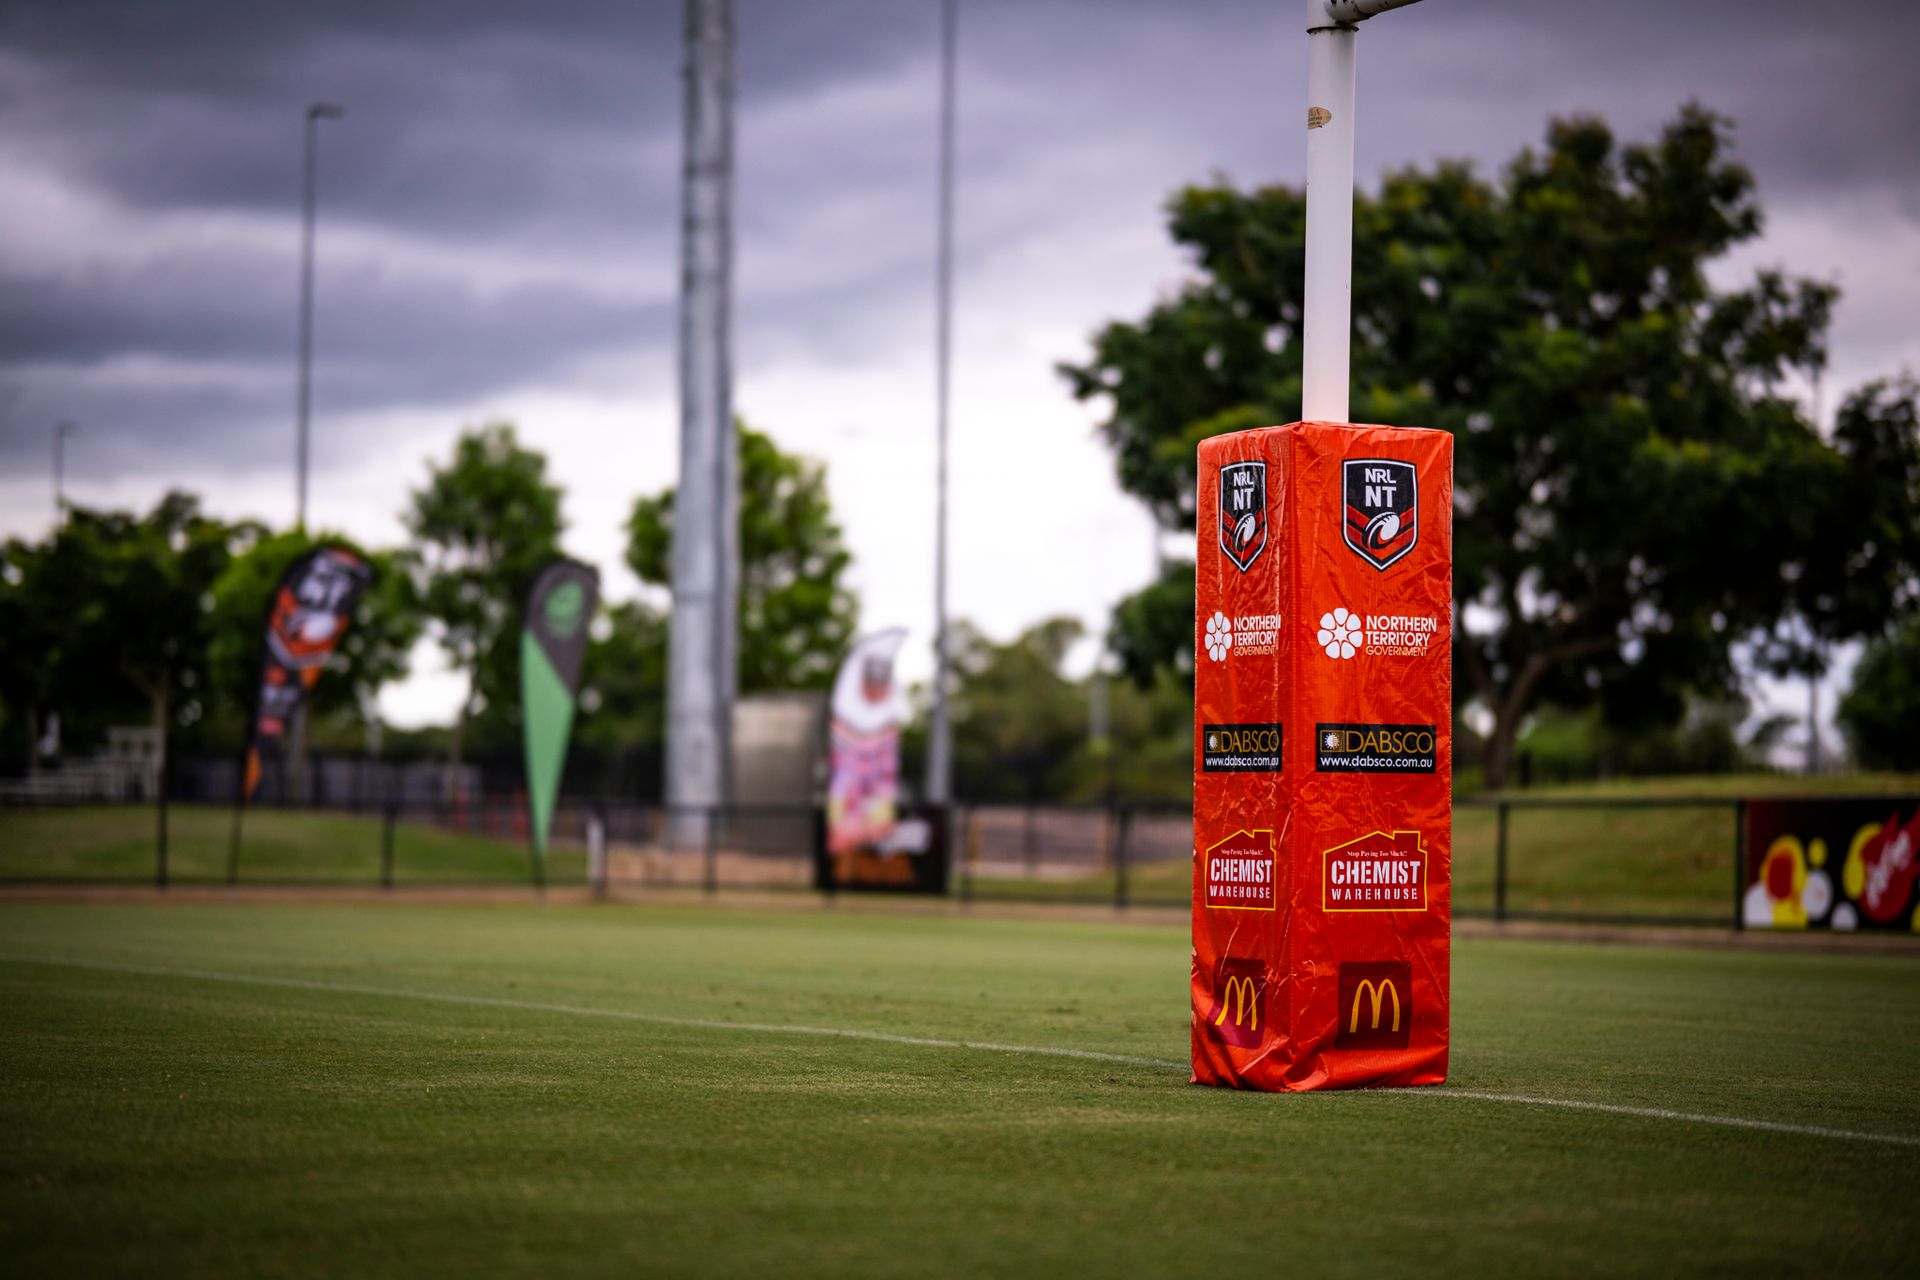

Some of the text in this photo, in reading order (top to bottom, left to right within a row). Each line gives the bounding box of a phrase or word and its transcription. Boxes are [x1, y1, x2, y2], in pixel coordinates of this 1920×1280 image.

[1234, 471, 1255, 487] NRL
[1364, 468, 1397, 484] NRL
[1233, 488, 1255, 510] NT
[1365, 485, 1397, 508] NT
[1233, 614, 1281, 631] NORTHERN
[1365, 615, 1437, 632] NORTHERN
[1233, 631, 1277, 646] TERRITORY
[1365, 631, 1430, 647] TERRITORY
[1233, 645, 1276, 657] GOVERNMENT
[1365, 646, 1428, 657] GOVERNMENT
[1220, 729, 1280, 753] DABSCO
[1345, 730, 1433, 754] DABSCO
[1205, 755, 1279, 767] www.dabsco.com.au
[1320, 755, 1433, 768] www.dabsco.com.au
[1210, 858, 1272, 883] CHEMIST
[1331, 860, 1420, 884] CHEMIST
[1210, 884, 1270, 898] WAREHOUSE
[1331, 888, 1418, 900] WAREHOUSE
